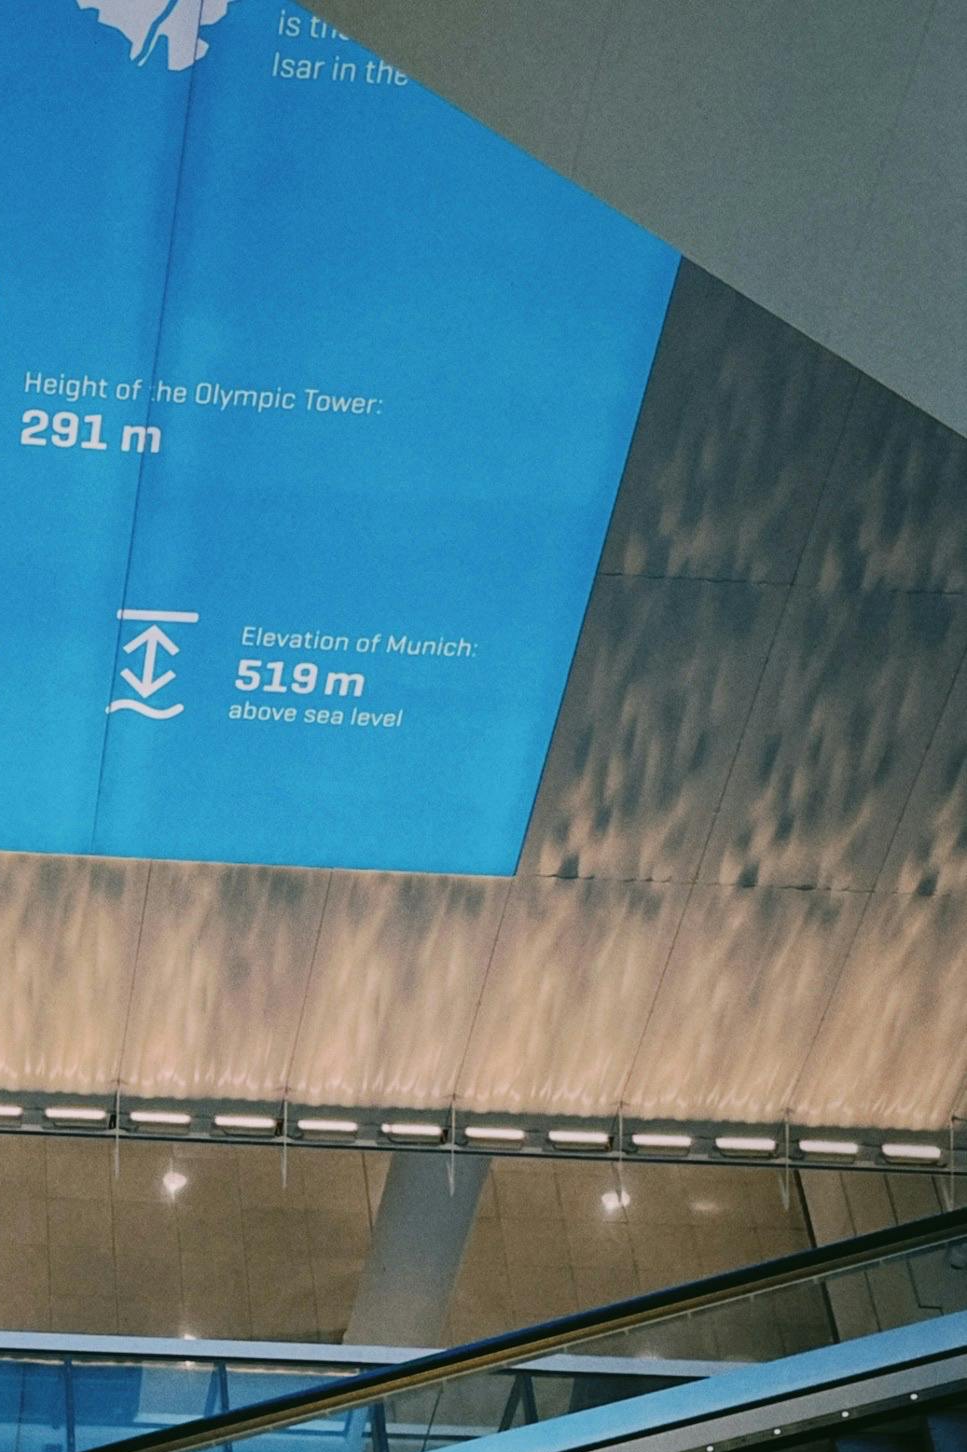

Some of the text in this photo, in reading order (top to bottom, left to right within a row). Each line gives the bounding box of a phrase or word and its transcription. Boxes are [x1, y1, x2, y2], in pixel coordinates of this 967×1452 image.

[278, 9, 302, 37] is
[271, 51, 326, 80] Isar
[332, 55, 357, 83] in
[24, 371, 108, 402] Height
[115, 379, 143, 401] of
[194, 382, 297, 413] Olympic
[303, 389, 384, 415] Tower:
[19, 408, 162, 454] 291 m
[240, 626, 479, 658] Elevation of Munich:
[234, 658, 365, 698] 519 m
[228, 701, 404, 728] above sea level
